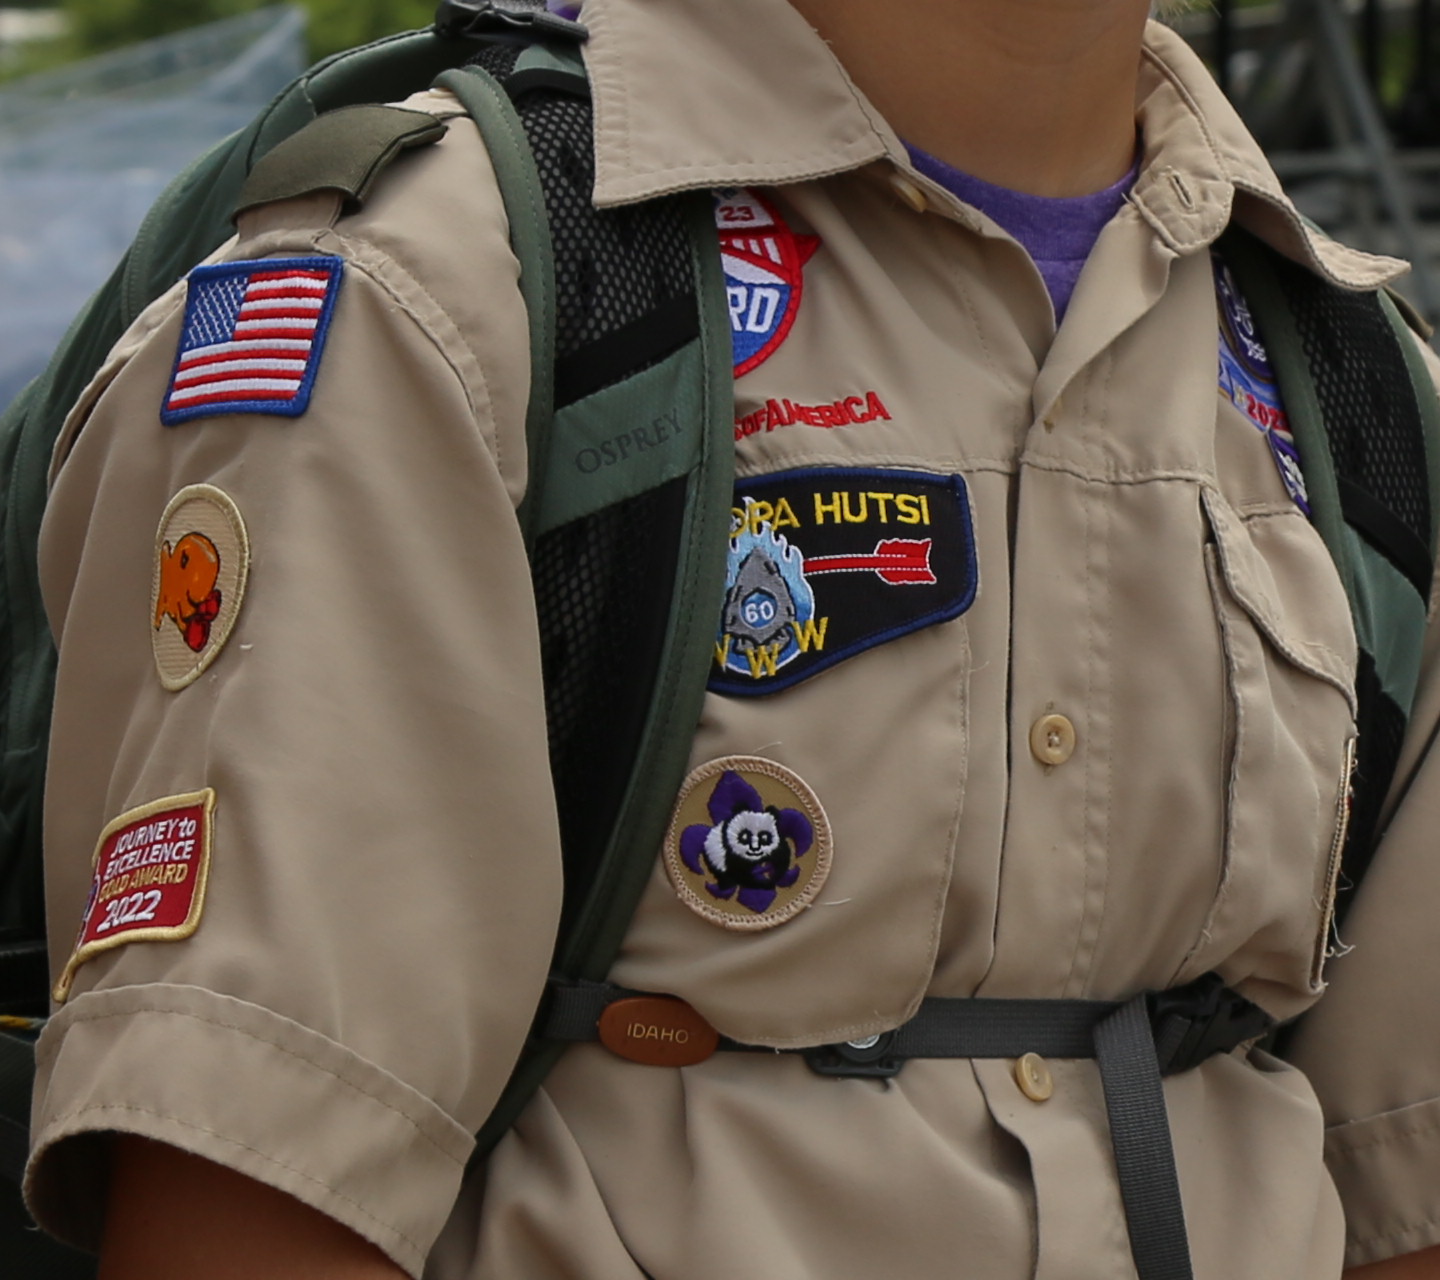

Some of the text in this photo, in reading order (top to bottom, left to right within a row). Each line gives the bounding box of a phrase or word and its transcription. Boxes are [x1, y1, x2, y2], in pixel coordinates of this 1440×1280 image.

[719, 205, 755, 221] 23
[764, 391, 892, 432] AMERICA
[575, 408, 682, 473] OSPREY
[729, 492, 931, 538] OPA HUTSI
[744, 601, 774, 623] 60
[111, 817, 197, 859] JOURNEY to
[104, 840, 195, 881] EXCELLENCE
[98, 863, 188, 903] GOLD AWARD
[96, 889, 162, 932] 2022
[627, 1023, 688, 1044] IDAHO
